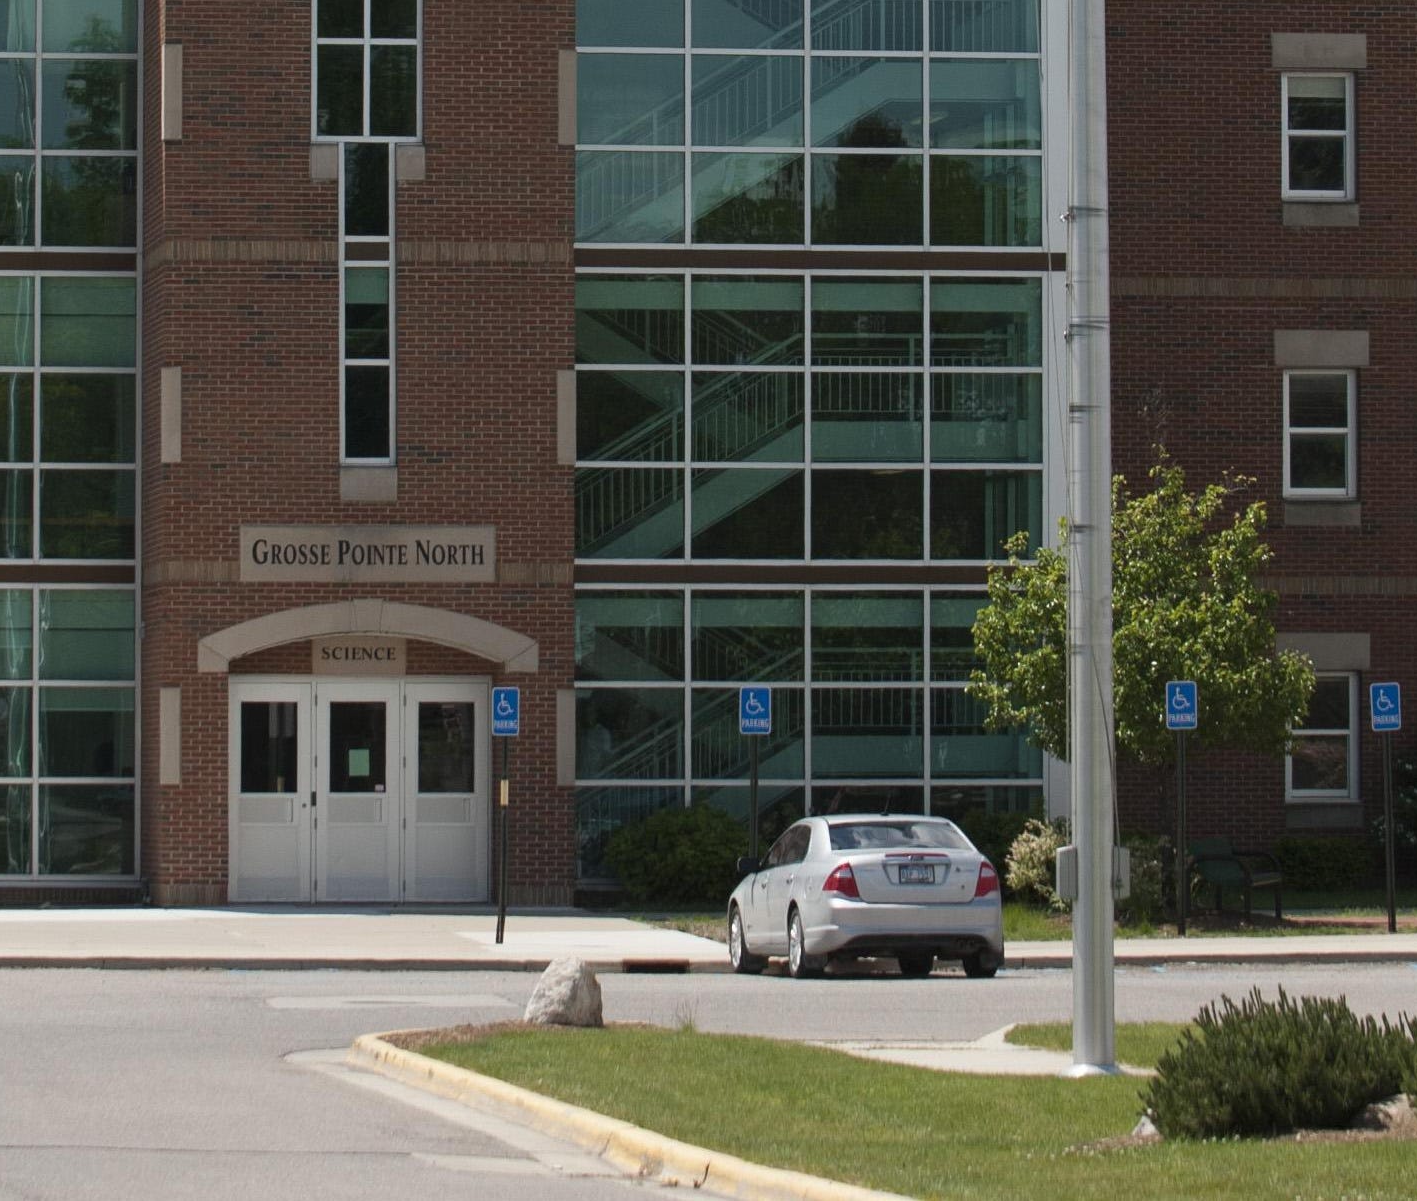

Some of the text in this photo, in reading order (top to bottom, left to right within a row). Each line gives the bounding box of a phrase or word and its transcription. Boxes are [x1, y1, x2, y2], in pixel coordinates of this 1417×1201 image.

[252, 538, 485, 566] GROSSE POINTE NORTH
[321, 645, 397, 661] SCIENCE
[494, 718, 518, 730] PARKING
[742, 718, 770, 730] PARKING
[1168, 714, 1195, 723] PARKING
[1373, 714, 1400, 725] PARKING
